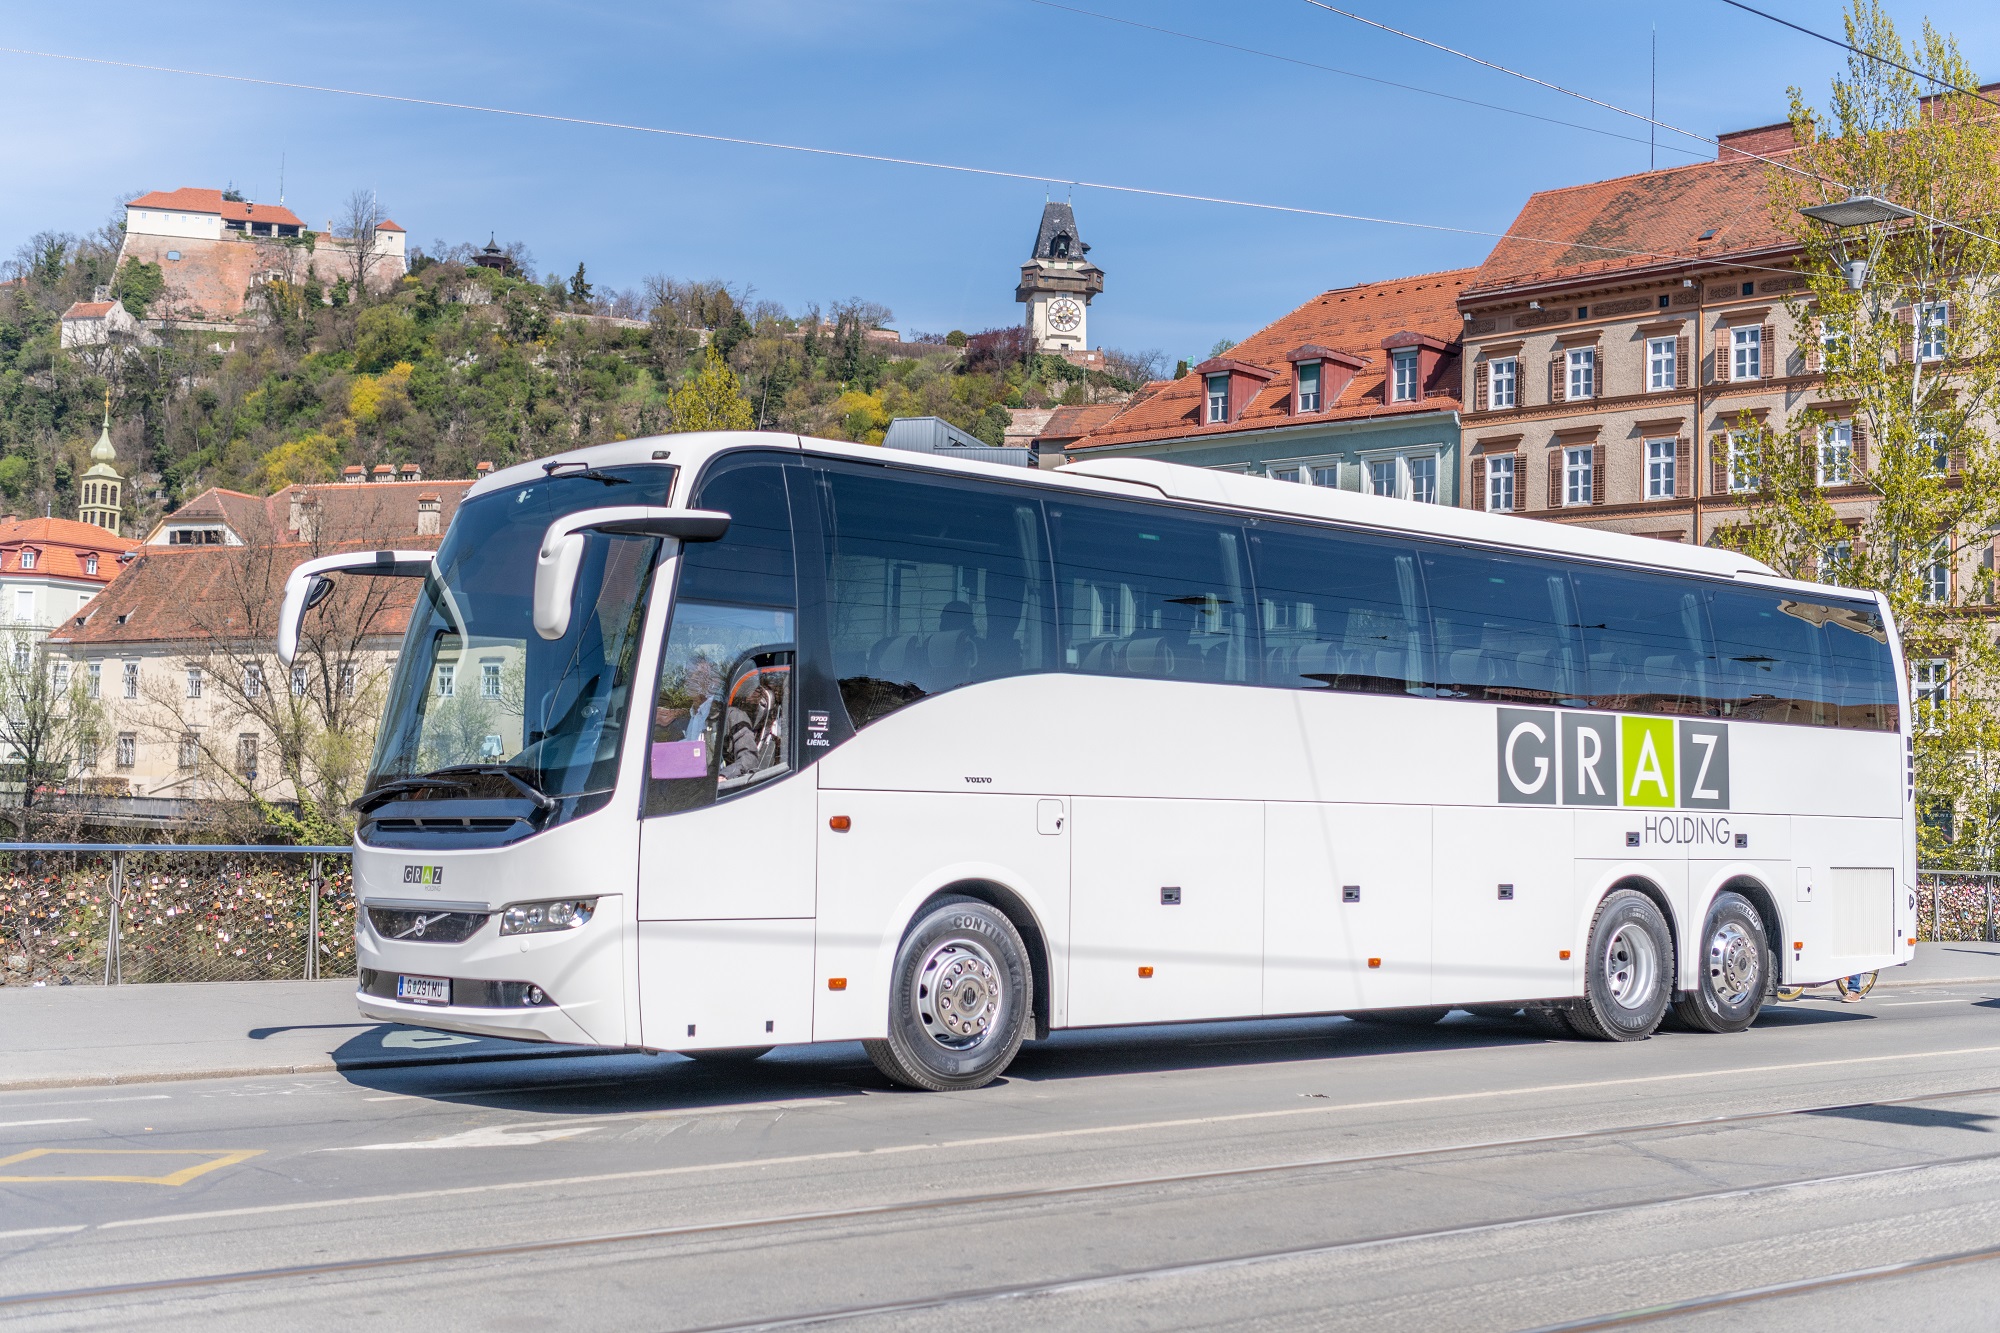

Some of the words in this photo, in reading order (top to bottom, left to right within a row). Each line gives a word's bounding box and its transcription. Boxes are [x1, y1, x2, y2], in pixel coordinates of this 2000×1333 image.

[806, 739, 830, 747] LIENDL
[1504, 721, 1719, 800] GRAZ
[964, 776, 993, 784] VOLVO
[1645, 815, 1730, 846] HOLDING
[404, 867, 441, 883] GRAZ
